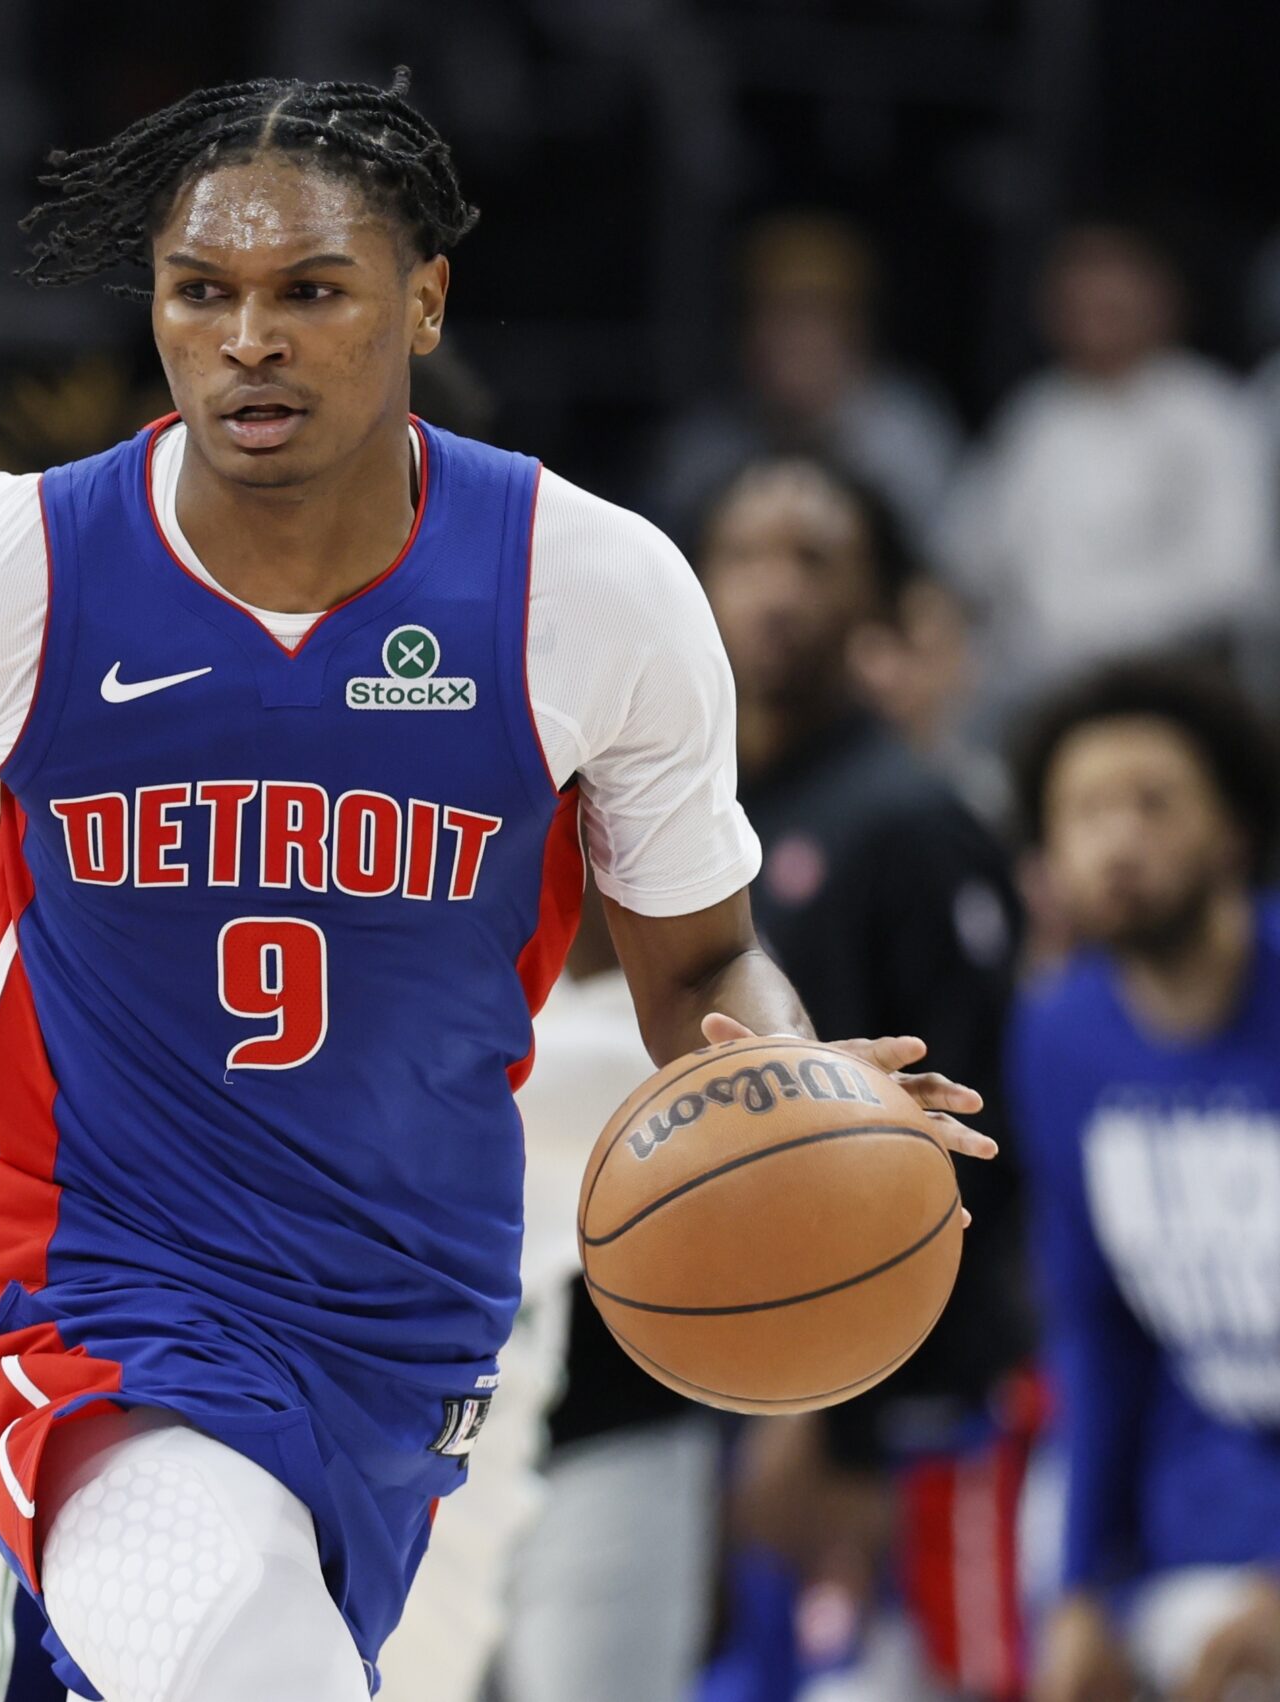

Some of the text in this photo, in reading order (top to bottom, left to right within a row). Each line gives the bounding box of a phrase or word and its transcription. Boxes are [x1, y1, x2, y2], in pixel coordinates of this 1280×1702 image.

[350, 681, 470, 705] StockX
[50, 780, 503, 901] DETROIT
[218, 916, 328, 1071] 9
[626, 1057, 884, 1161] Wilson
